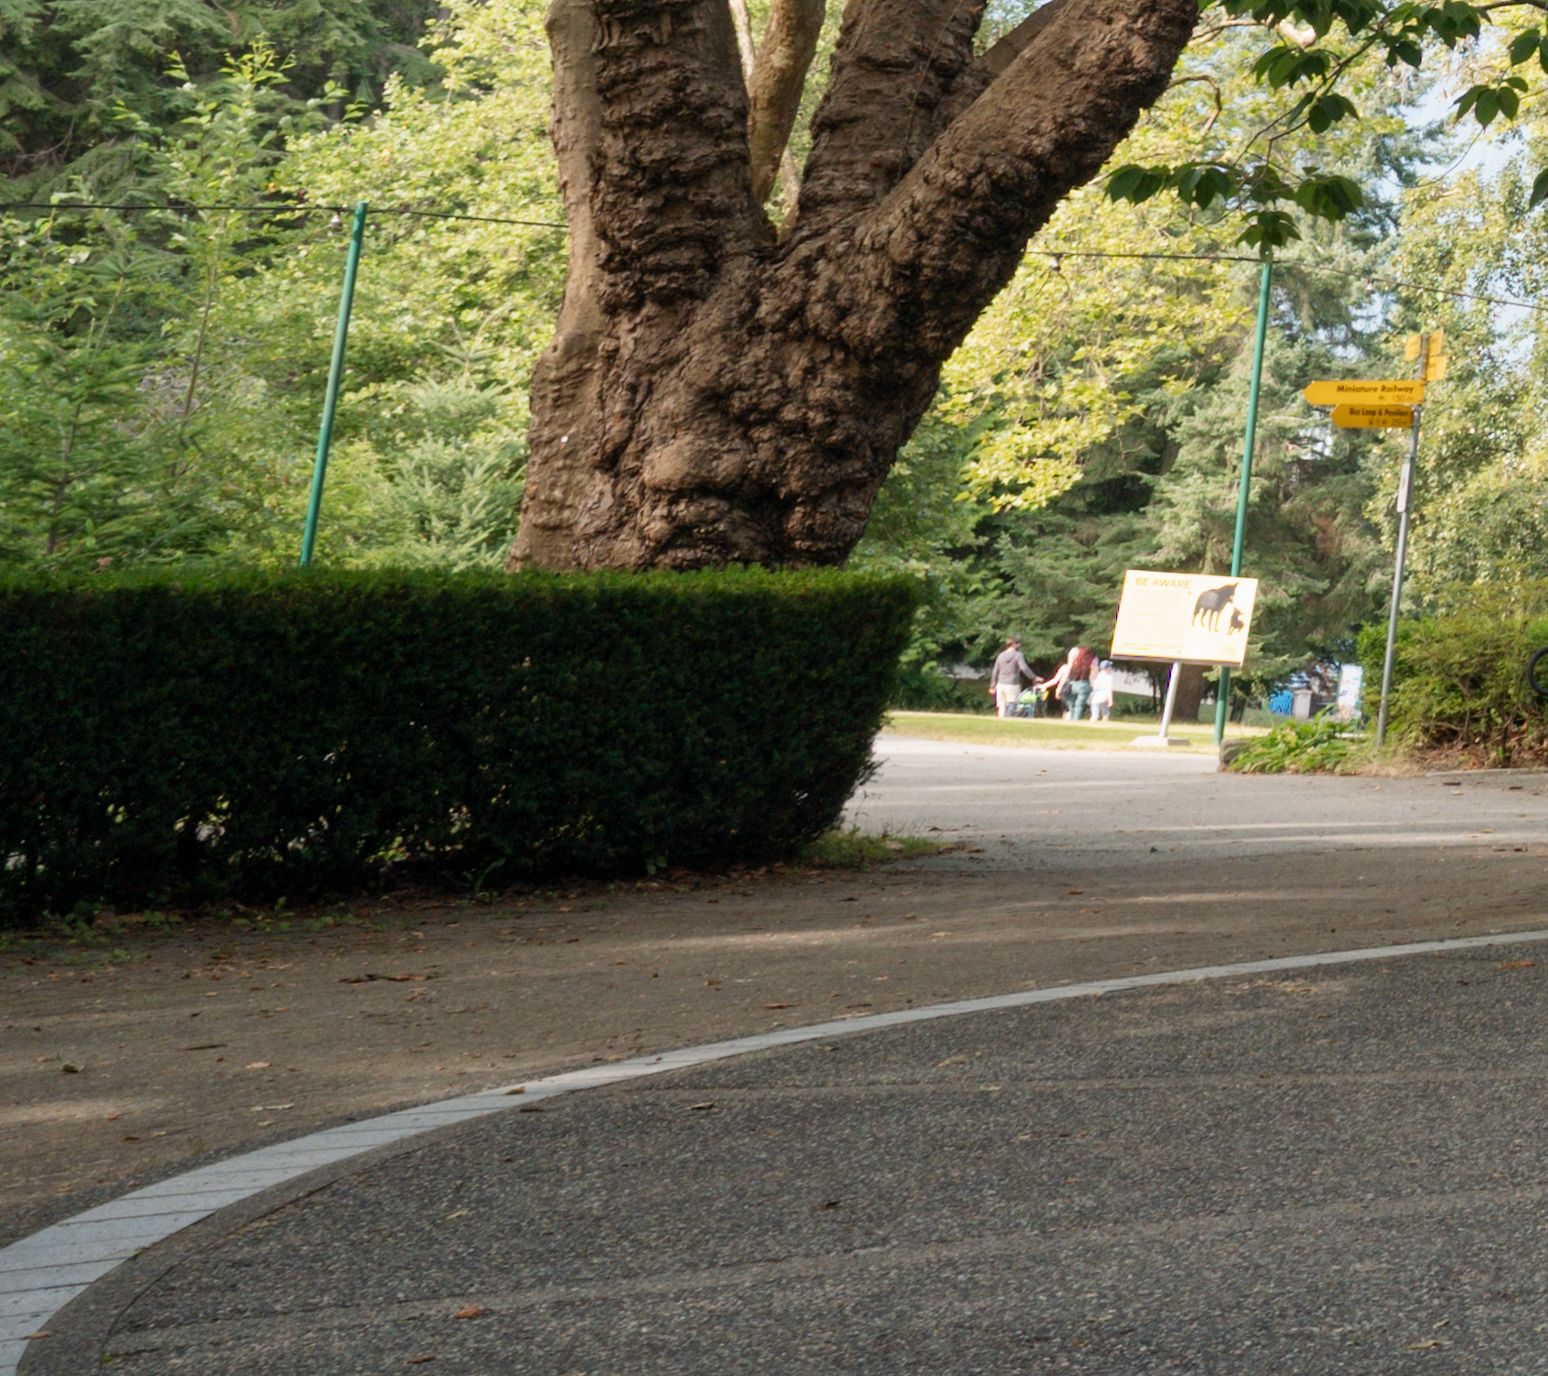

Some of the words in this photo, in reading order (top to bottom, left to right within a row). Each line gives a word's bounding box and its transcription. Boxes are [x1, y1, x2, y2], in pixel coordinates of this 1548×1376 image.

[1336, 385, 1378, 393] Miniature
[1381, 385, 1414, 394] Railway
[1136, 577, 1148, 586] BE
[1152, 578, 1192, 589] AWARE
